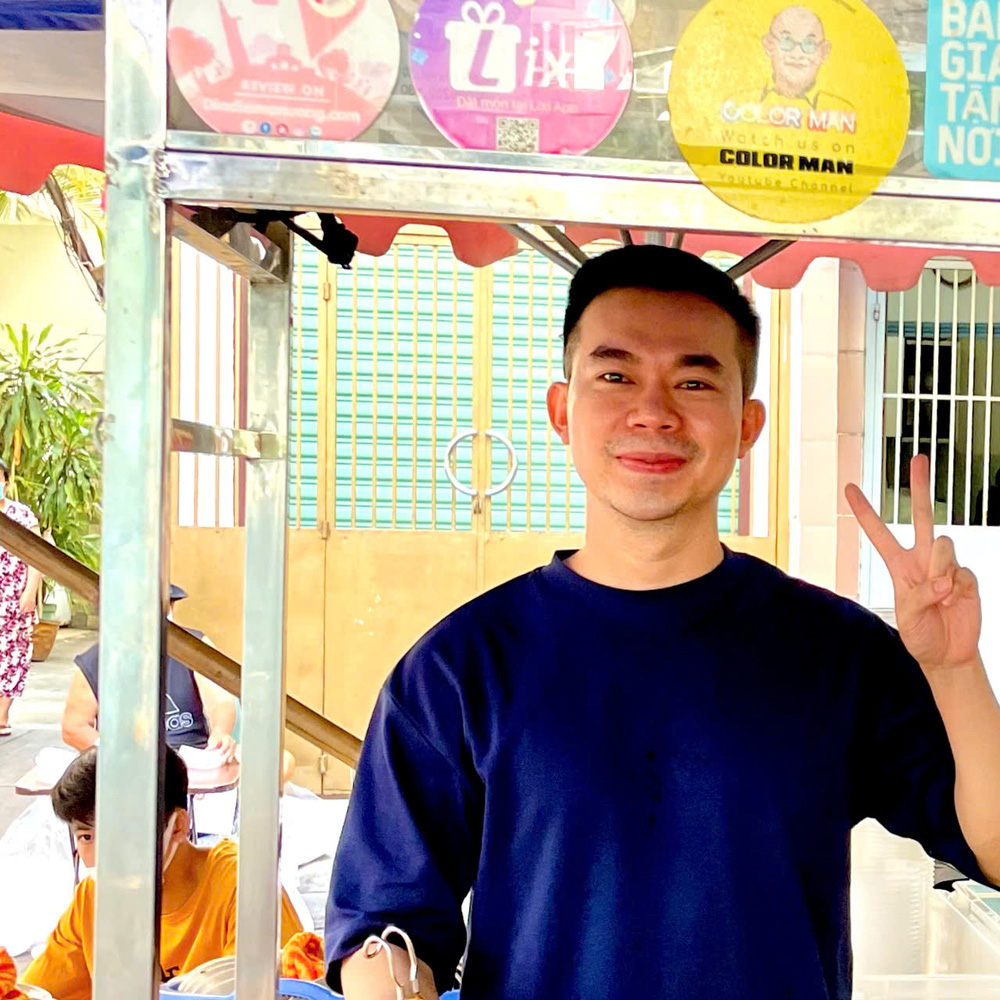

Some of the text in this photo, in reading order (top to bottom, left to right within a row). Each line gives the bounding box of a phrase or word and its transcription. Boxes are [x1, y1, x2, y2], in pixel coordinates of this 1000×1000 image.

[722, 100, 856, 135] COLOR MAN
[720, 130, 856, 155] Watch us on
[719, 148, 854, 175] COLOR MAN
[718, 171, 853, 193] Youtube Channel
